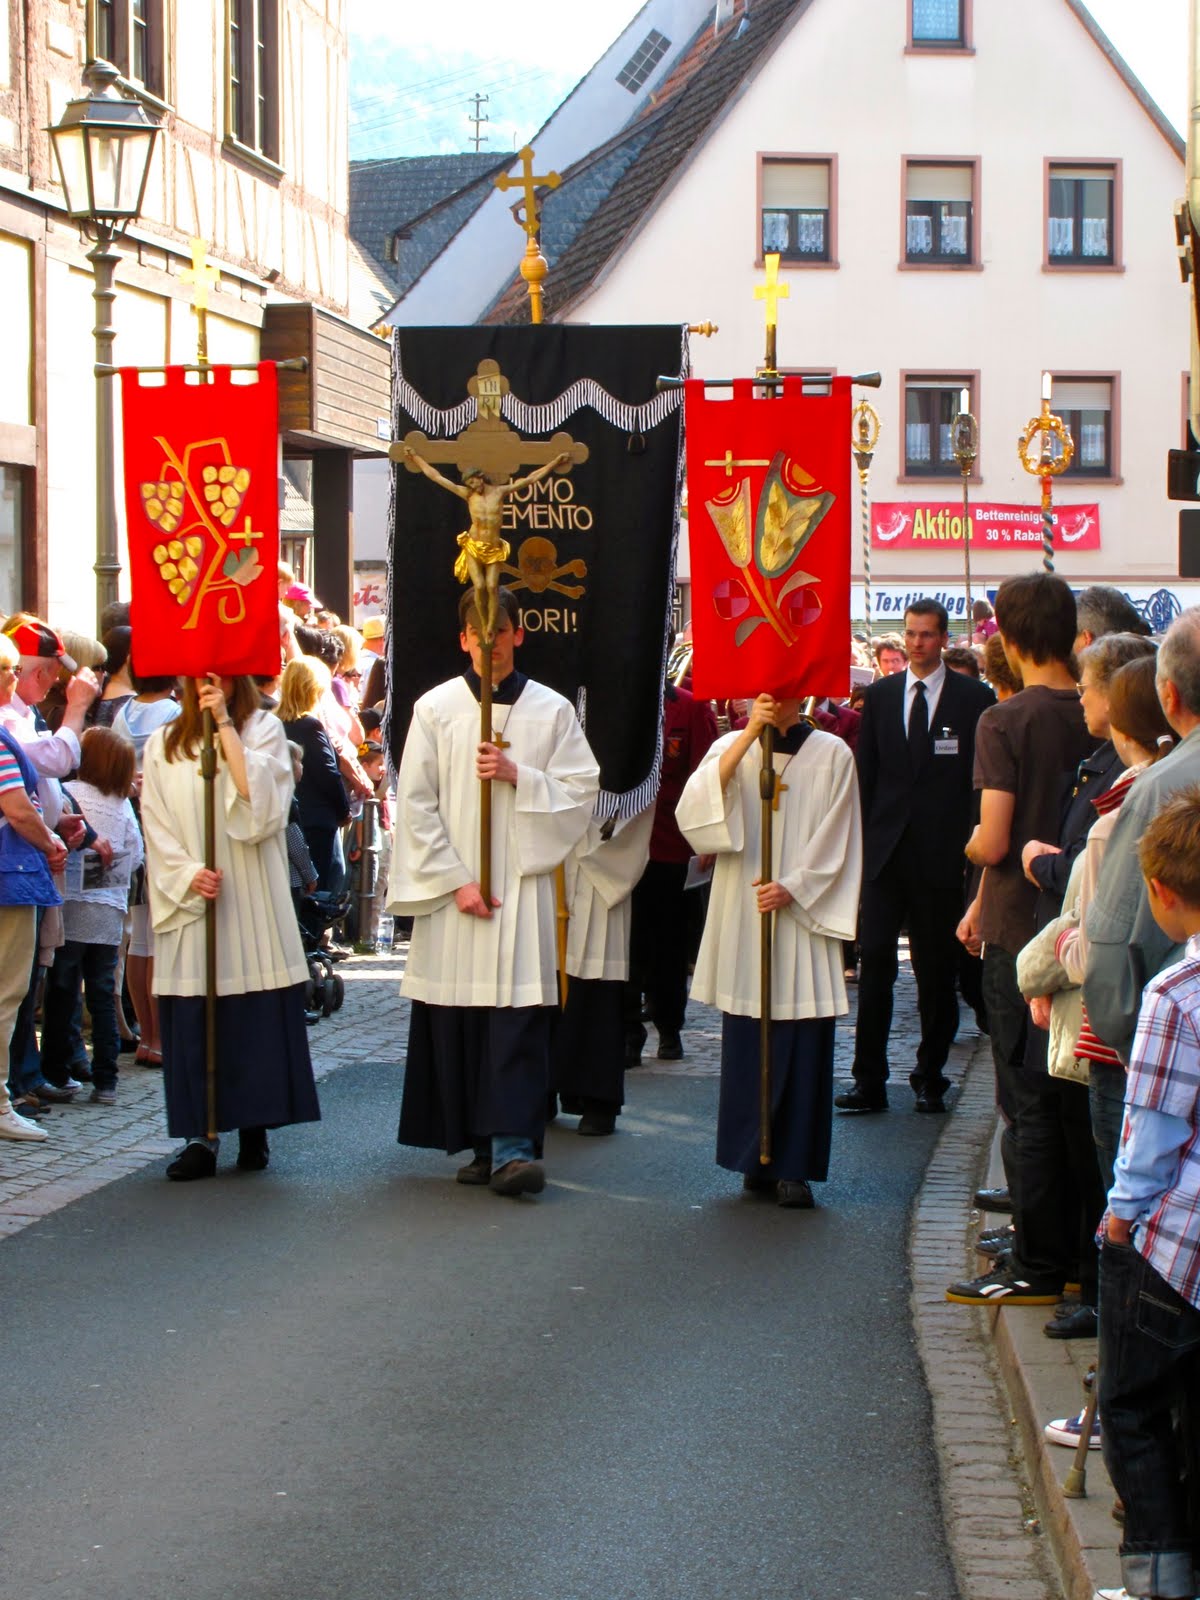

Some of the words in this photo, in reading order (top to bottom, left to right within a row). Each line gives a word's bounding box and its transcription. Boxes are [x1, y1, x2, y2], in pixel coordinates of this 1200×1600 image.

[483, 379, 497, 393] IN
[500, 503, 593, 531] EMENTO
[912, 508, 974, 541] Aktion
[986, 528, 999, 541] 30
[1001, 529, 1011, 541] %
[1014, 529, 1045, 541] Rabat
